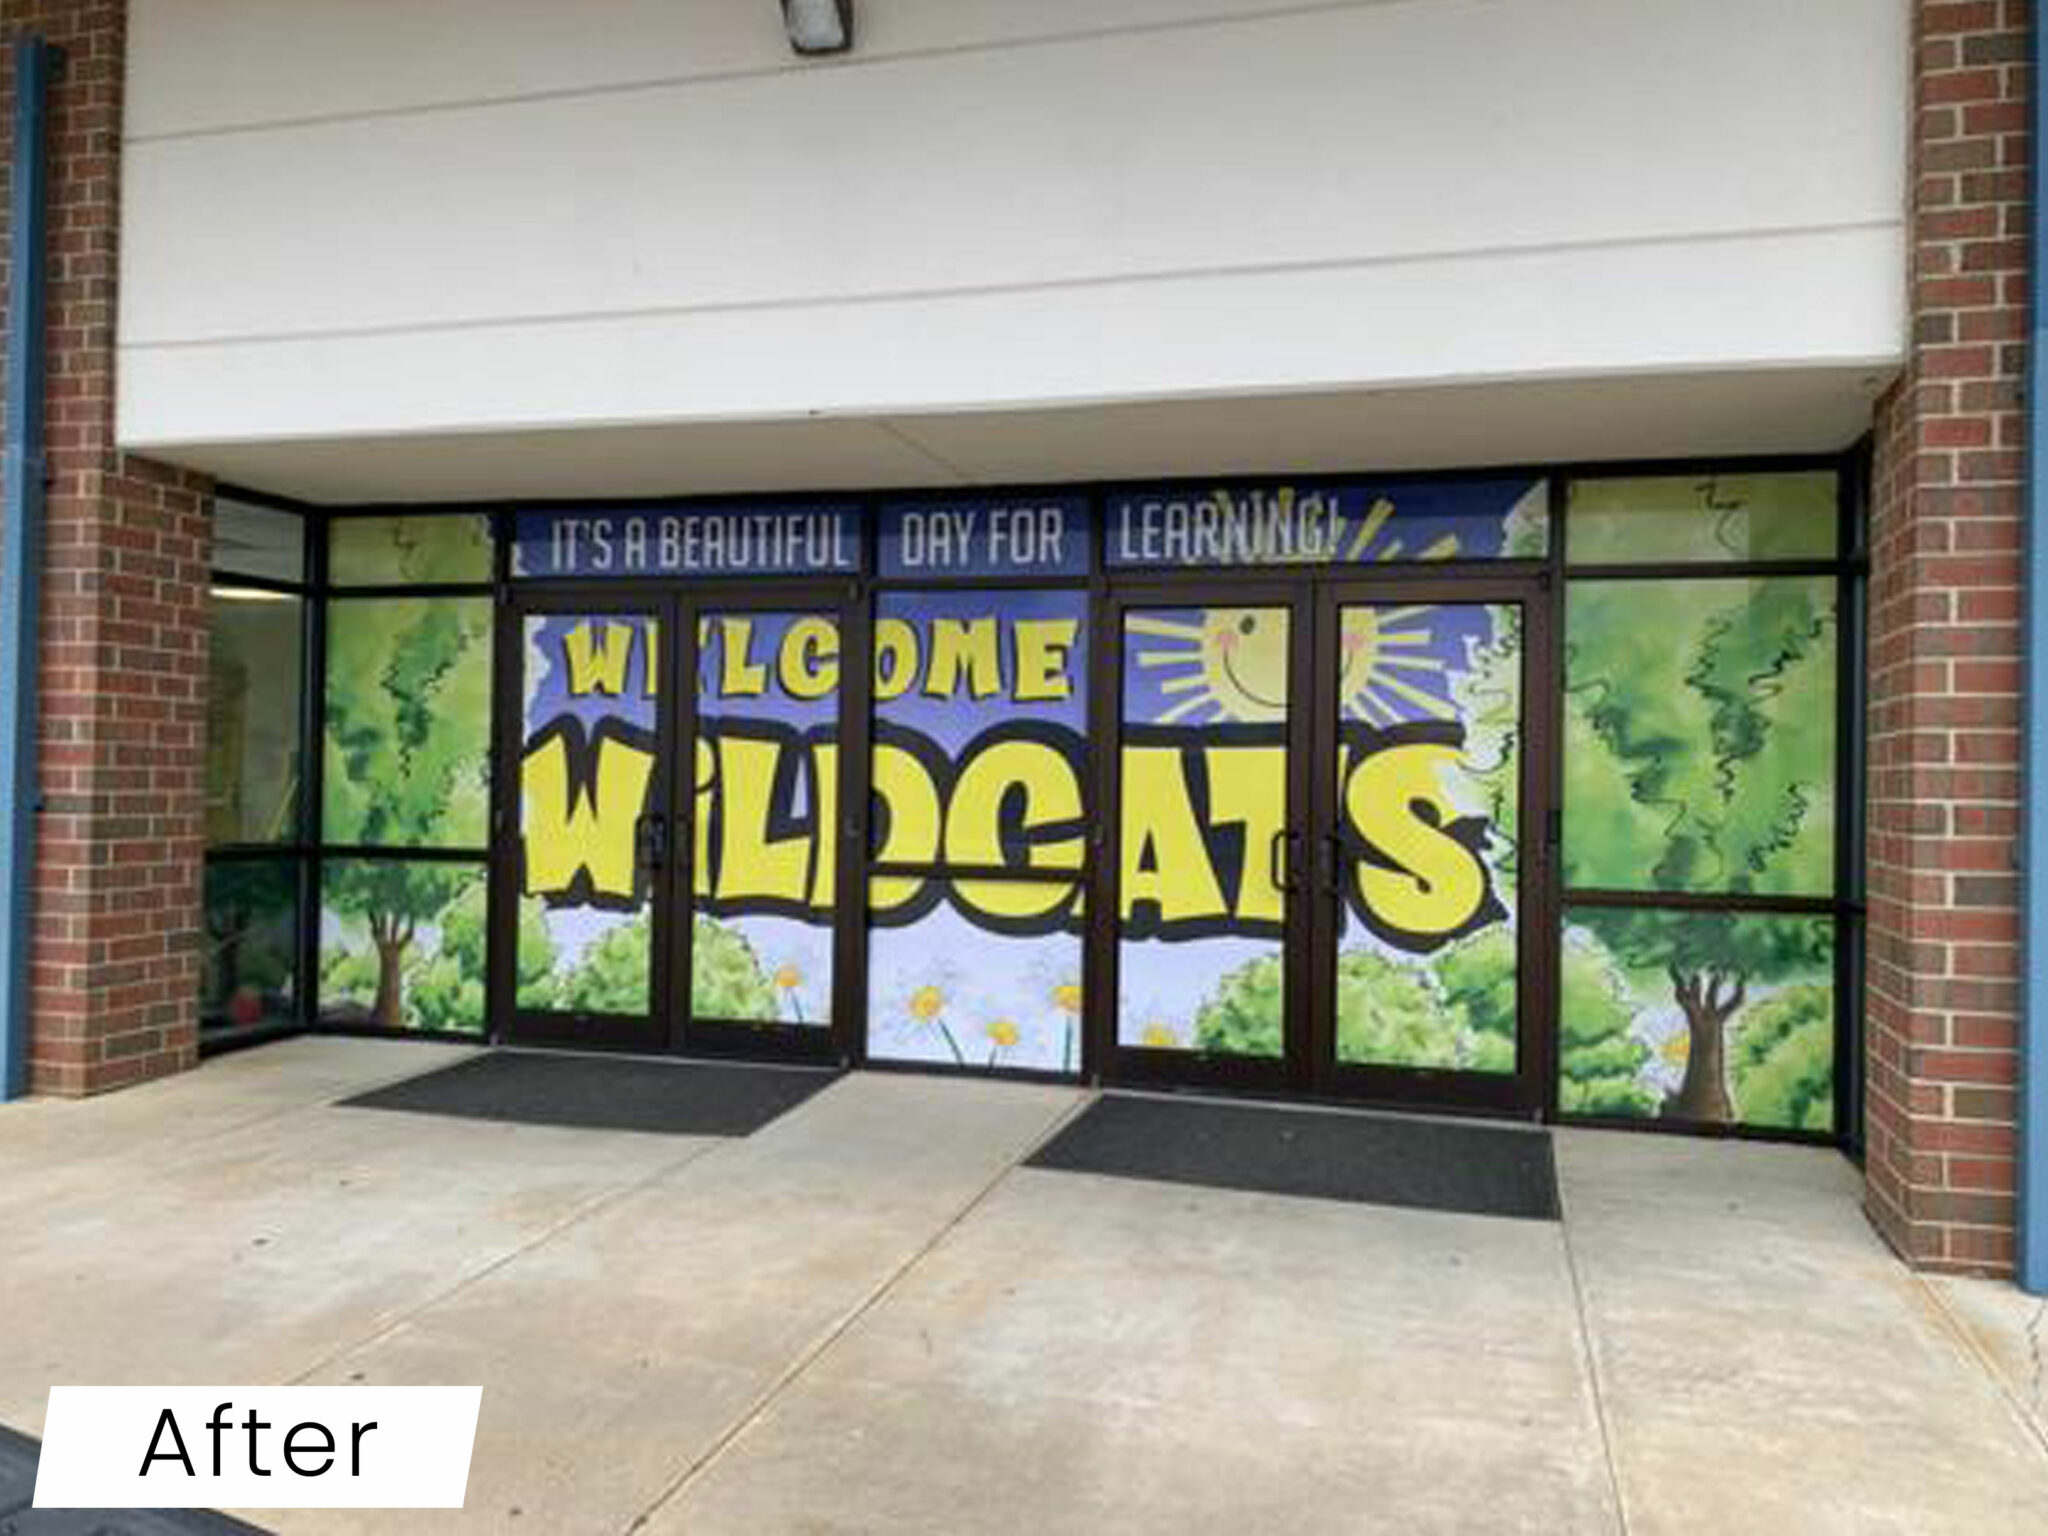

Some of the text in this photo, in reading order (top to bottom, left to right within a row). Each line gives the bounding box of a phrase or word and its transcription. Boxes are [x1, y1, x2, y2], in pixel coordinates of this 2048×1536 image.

[551, 496, 1339, 571] IT'S A BEAUTIFUL DAY FOR LEARNING!
